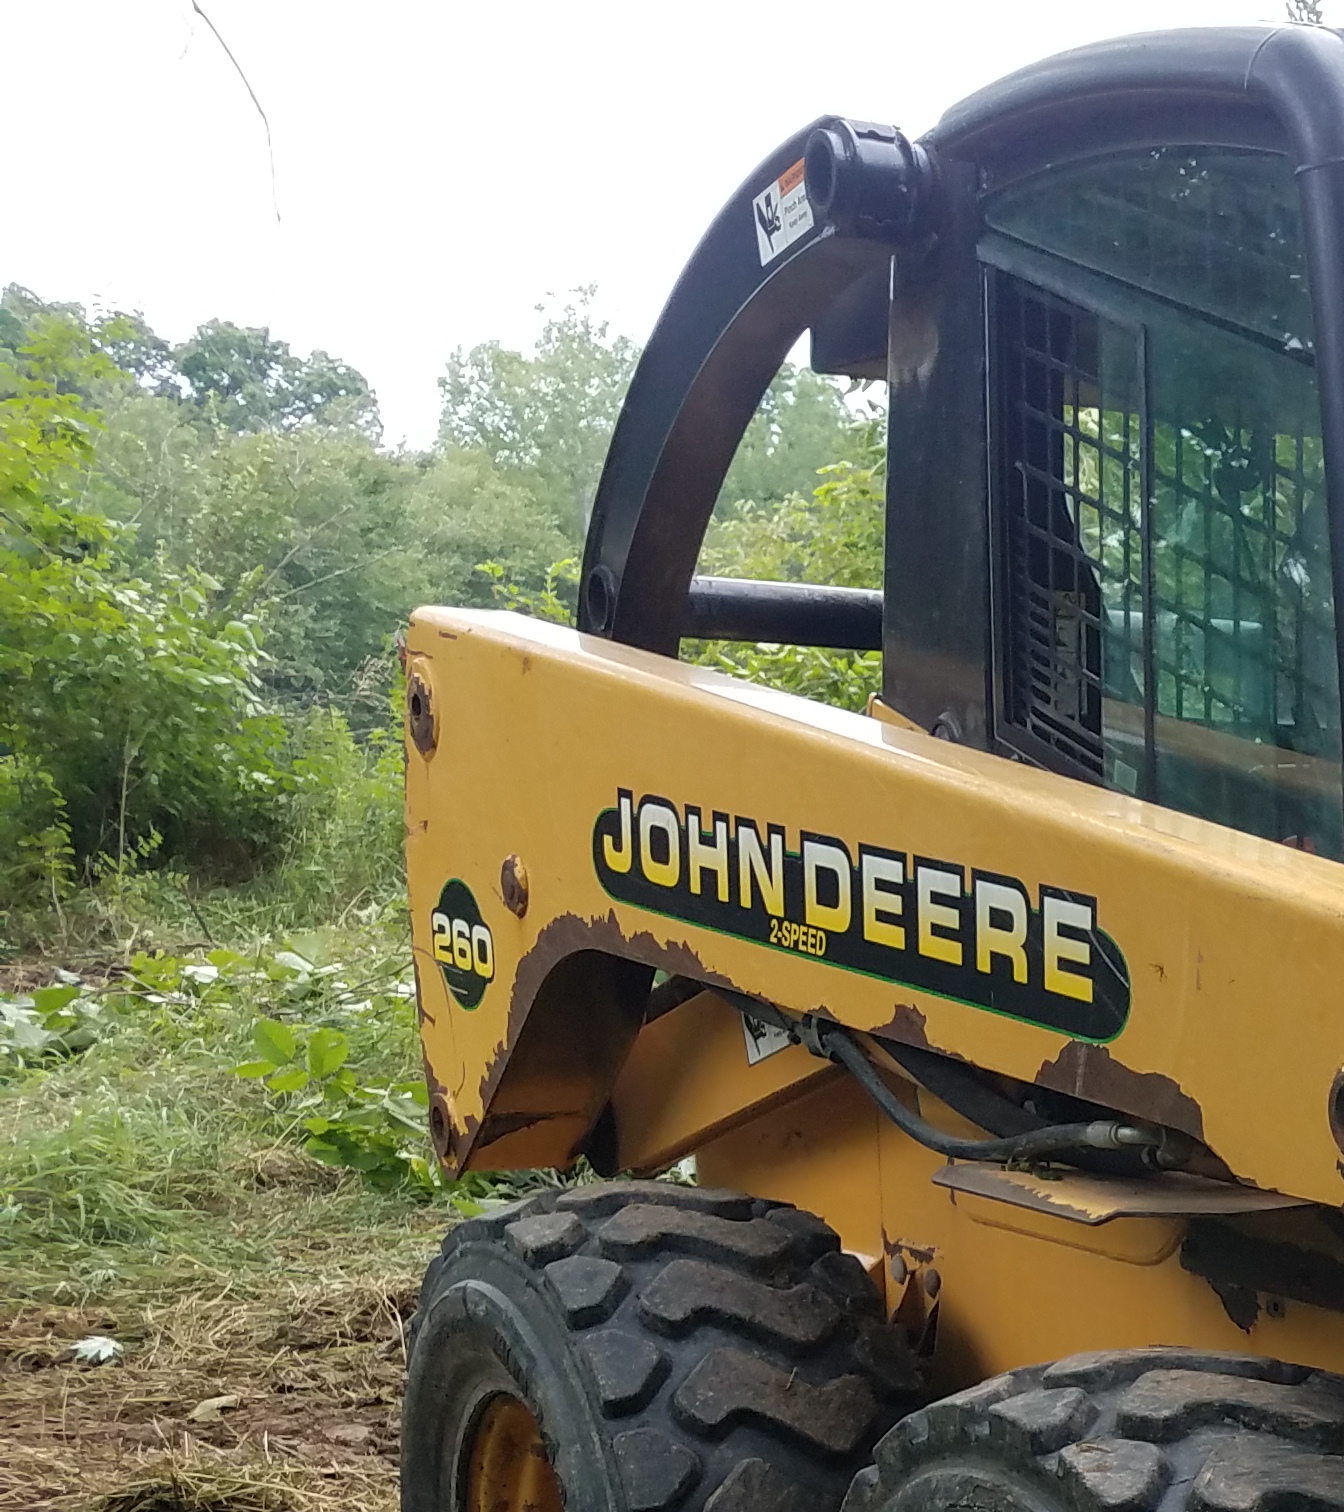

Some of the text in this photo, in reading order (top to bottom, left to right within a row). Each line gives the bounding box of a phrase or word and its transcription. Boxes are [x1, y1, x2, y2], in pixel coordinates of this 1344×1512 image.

[603, 797, 1093, 1004] JOHN DEERE
[432, 912, 493, 979] 260
[770, 918, 826, 956] 2-SPEED
